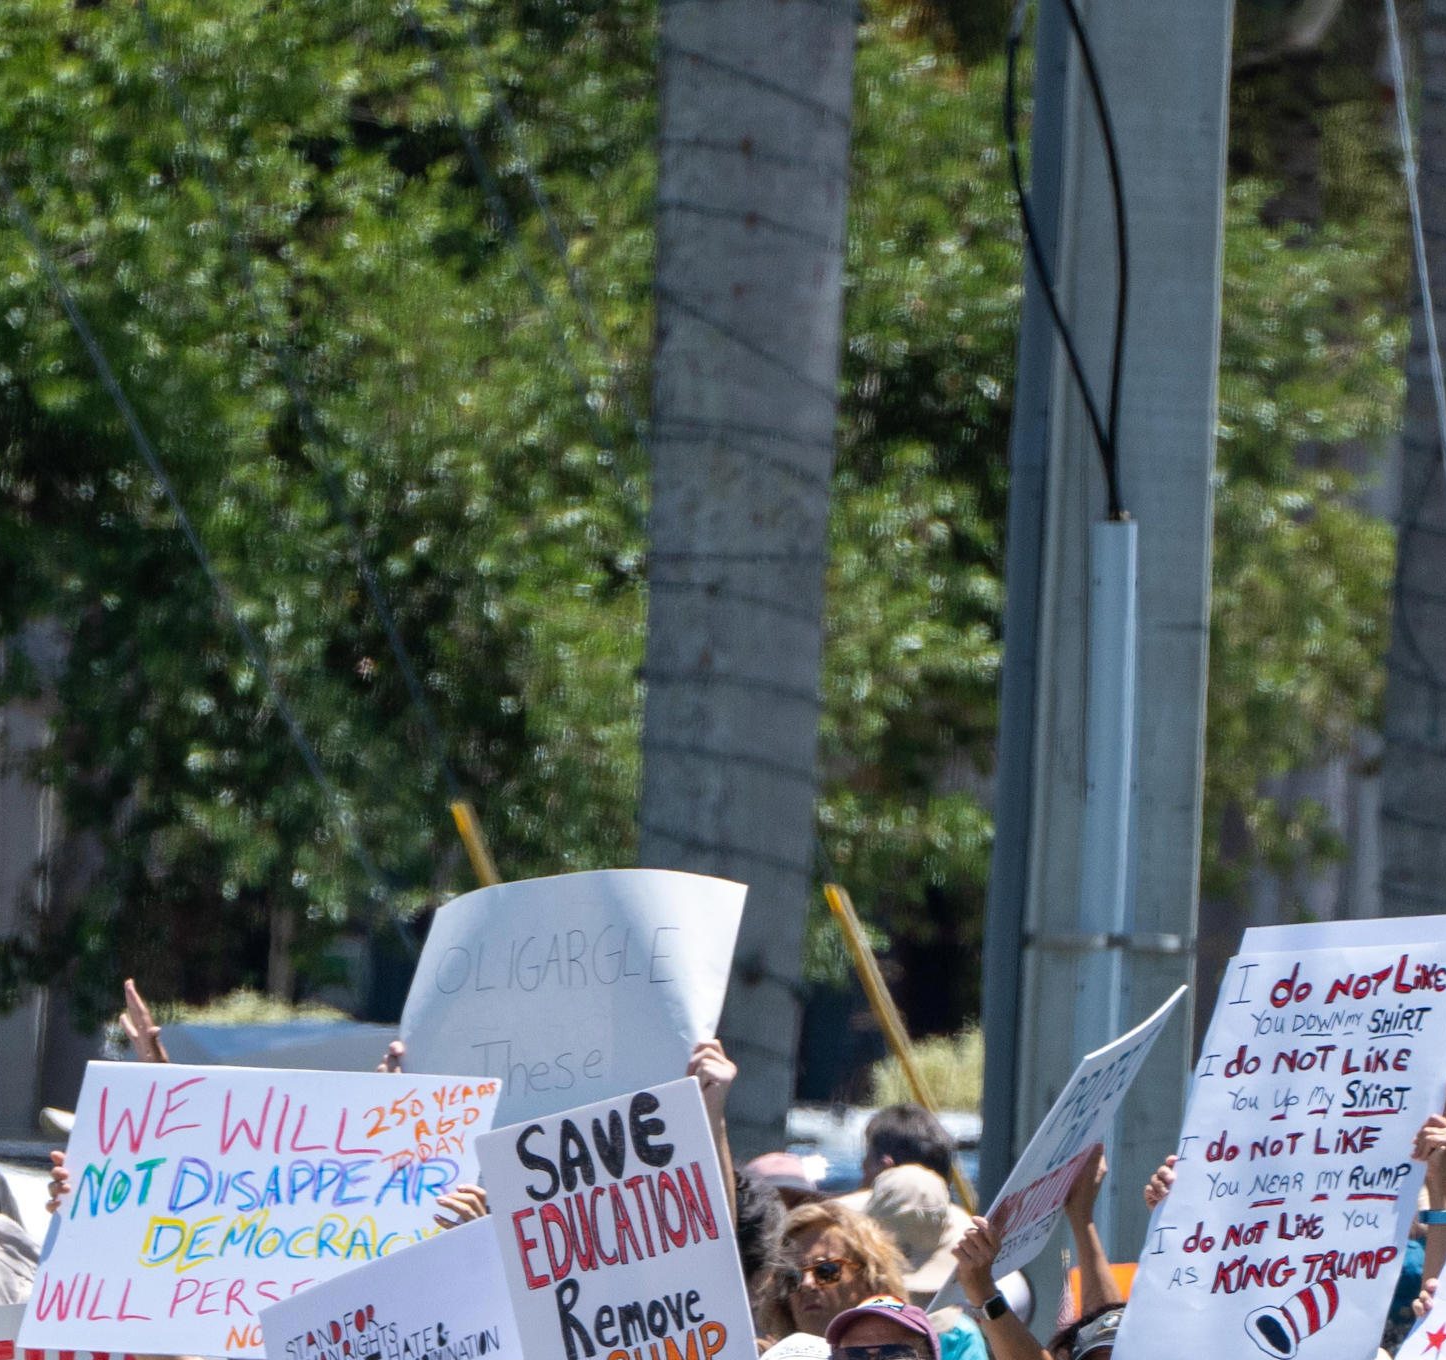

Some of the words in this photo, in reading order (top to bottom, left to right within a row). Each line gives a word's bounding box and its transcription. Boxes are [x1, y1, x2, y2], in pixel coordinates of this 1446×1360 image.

[1229, 964, 1259, 1005] I
[1270, 962, 1312, 1008] do
[1324, 964, 1393, 1005] NOT
[471, 1040, 605, 1097] These
[1200, 1054, 1221, 1077] I
[1224, 1044, 1261, 1078] do
[1271, 1044, 1337, 1074] NOT
[99, 1077, 207, 1155] WE
[219, 1087, 382, 1156] WILL
[362, 1087, 425, 1140] 250
[413, 1106, 481, 1143] AGO
[516, 1091, 674, 1202] SAVE
[1176, 1136, 1200, 1161] I
[1205, 1130, 1240, 1163] do
[1250, 1132, 1305, 1161] NOT
[70, 1156, 167, 1220] NOT
[168, 1156, 460, 1213] DISAPPEAR
[512, 1162, 719, 1290] EDUCATION
[1150, 1226, 1177, 1254] I
[1183, 1221, 1215, 1252] do
[1221, 1221, 1269, 1250] NOT
[1167, 1266, 1199, 1290] AS
[1302, 1245, 1398, 1283] TRUMP
[36, 1272, 153, 1322] WILL
[343, 1304, 380, 1340] FOR
